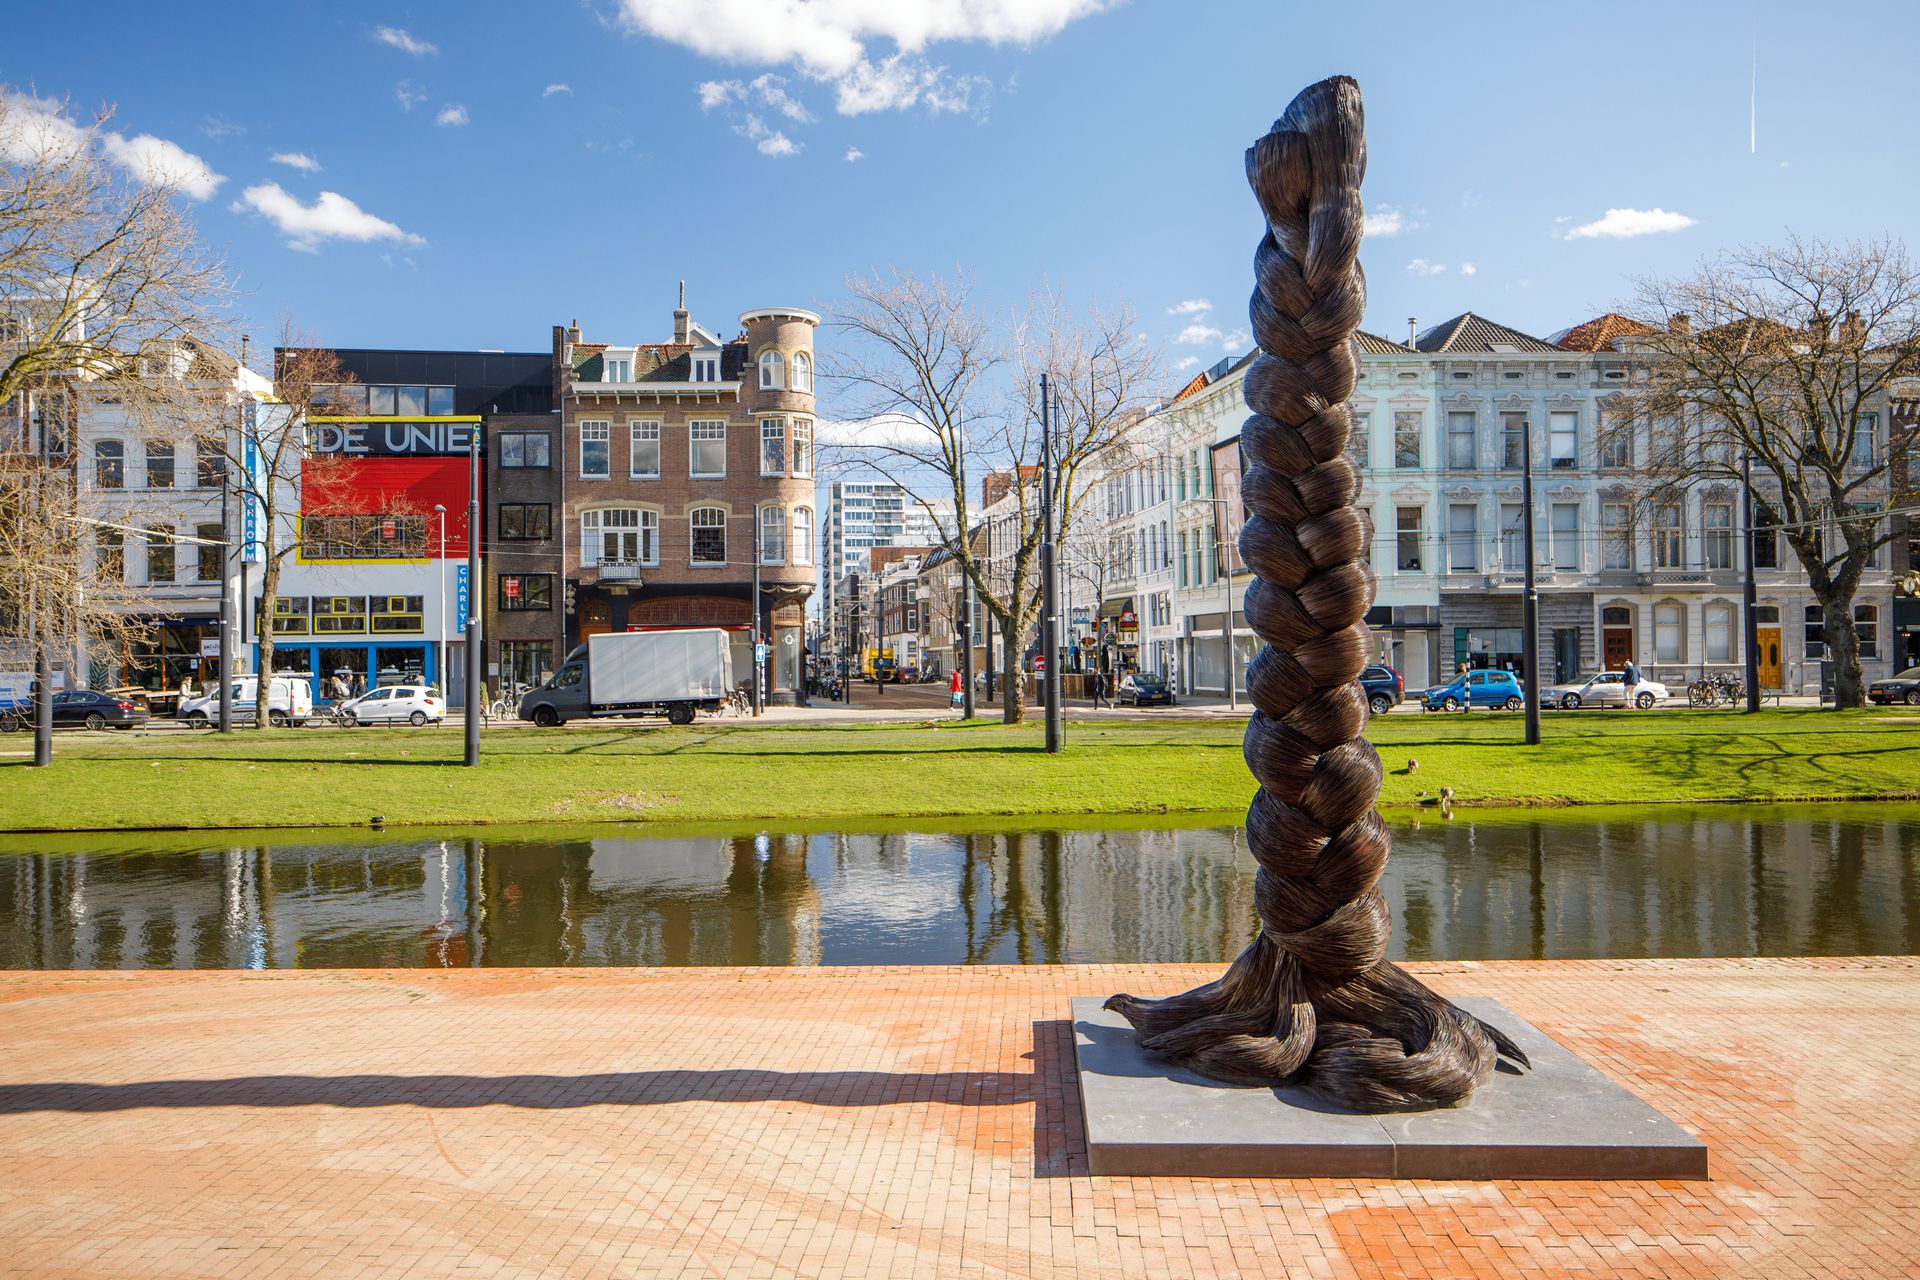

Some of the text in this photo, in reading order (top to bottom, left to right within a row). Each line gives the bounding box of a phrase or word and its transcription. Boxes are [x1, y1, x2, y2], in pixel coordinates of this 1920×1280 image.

[318, 423, 473, 452] DE UNIE
[459, 567, 467, 632] CHARLY'S
